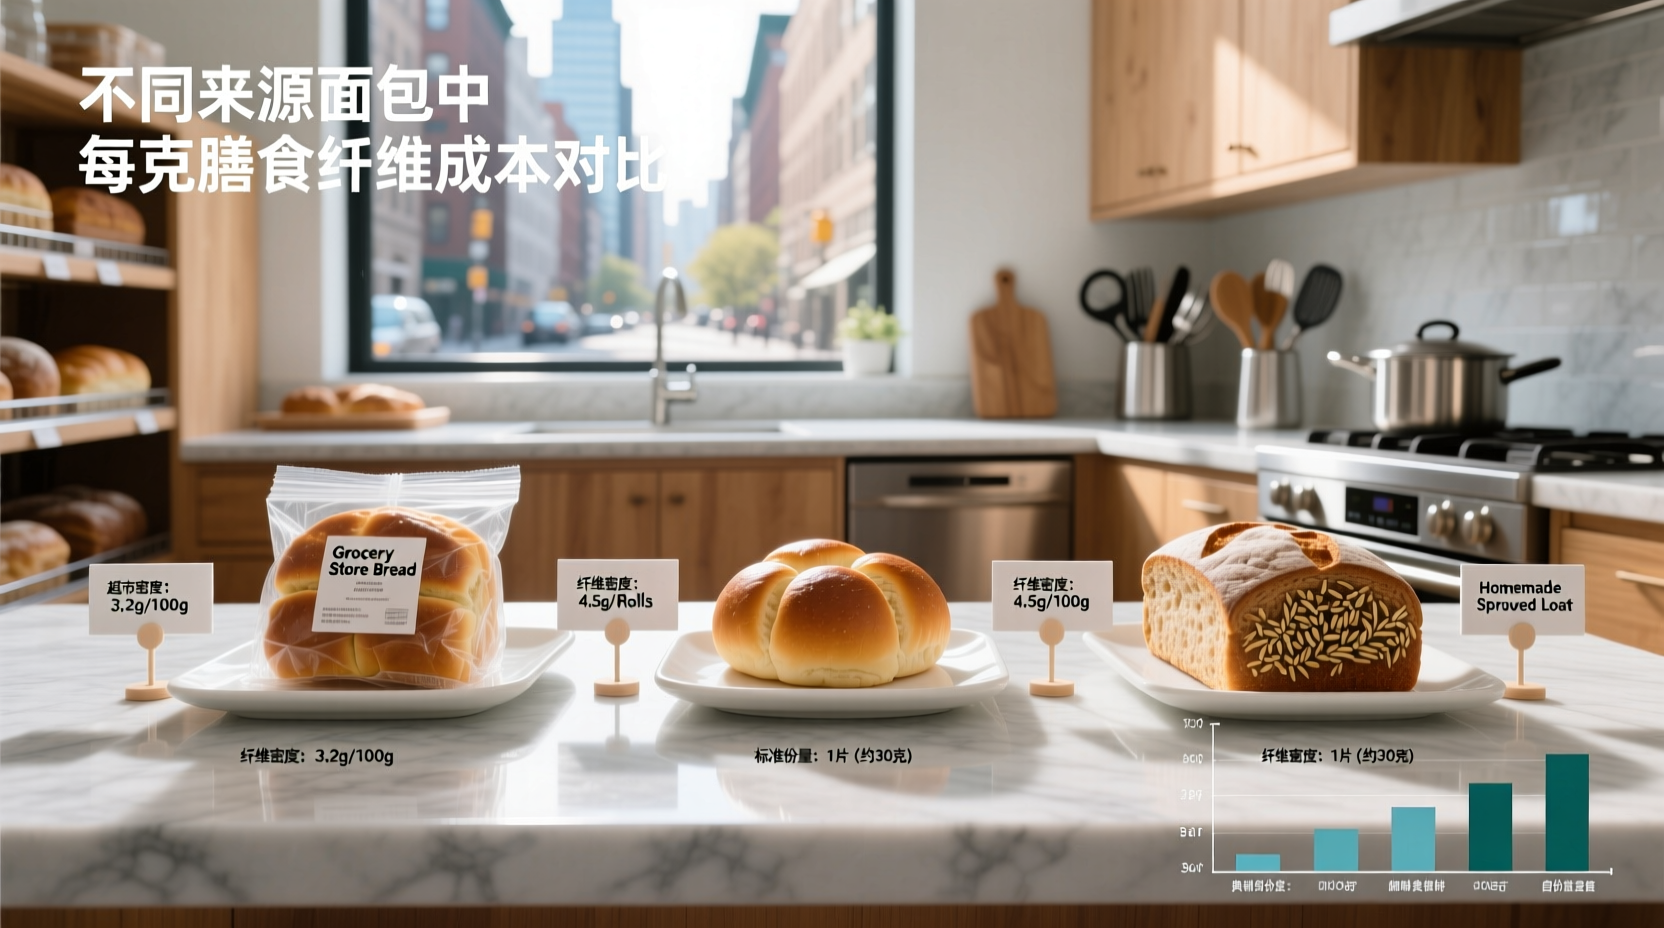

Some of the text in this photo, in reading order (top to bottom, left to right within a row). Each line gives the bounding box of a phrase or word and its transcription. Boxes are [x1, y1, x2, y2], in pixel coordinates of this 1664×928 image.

[333, 545, 394, 563] Grocery
[329, 562, 416, 577] Store Bread
[1480, 580, 1561, 594] Homemade
[579, 592, 653, 611] 4.5g/Rolls
[1014, 594, 1089, 612] 4.5g/100g
